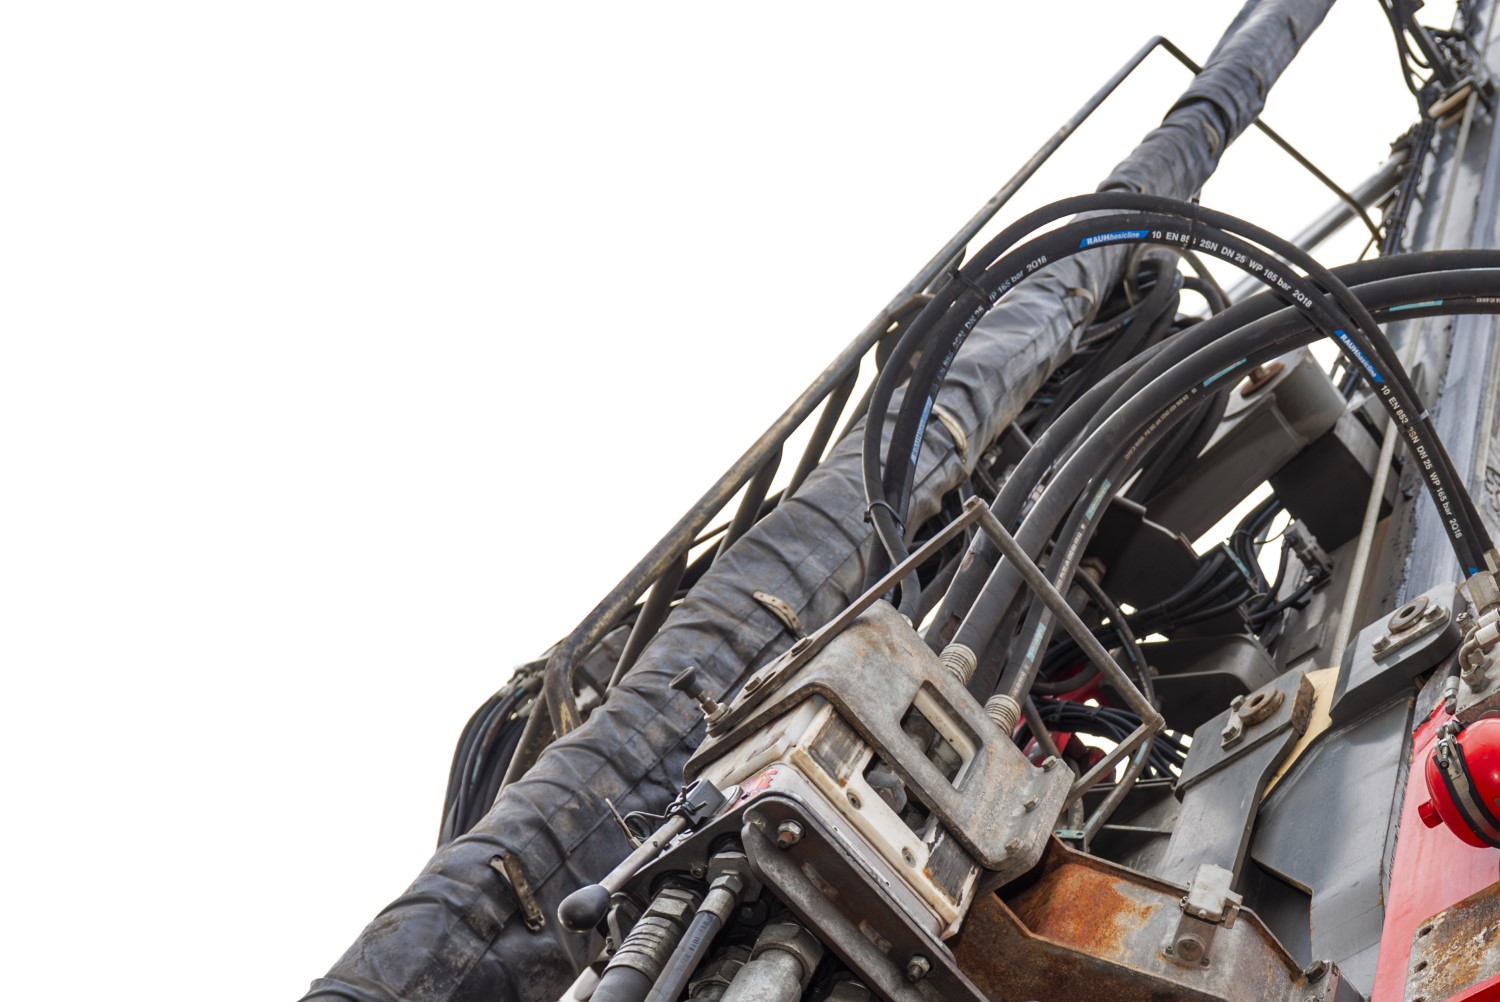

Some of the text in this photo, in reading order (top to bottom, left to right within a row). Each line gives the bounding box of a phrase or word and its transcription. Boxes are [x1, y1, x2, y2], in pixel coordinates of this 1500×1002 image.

[1010, 269, 1025, 283] bar
[1025, 255, 1048, 272] 2Q18
[1086, 230, 1140, 246] RAUHbasicline
[1151, 230, 1162, 240] 10
[1165, 231, 1180, 243] EN
[1199, 239, 1219, 252] 2SN
[1220, 246, 1235, 259] DN
[1234, 252, 1247, 264] 25
[1248, 259, 1264, 272] WP
[1263, 268, 1278, 283] 165
[1277, 277, 1292, 291] bar
[1291, 289, 1313, 309] 2Q18
[1380, 384, 1390, 396] 10
[1388, 396, 1400, 411] EN
[1416, 446, 1428, 460] DN
[1423, 459, 1432, 470] 25
[1428, 471, 1441, 486] WP
[1436, 487, 1447, 502] 165
[1442, 501, 1453, 515] bar
[1449, 518, 1463, 539] 2Q18
